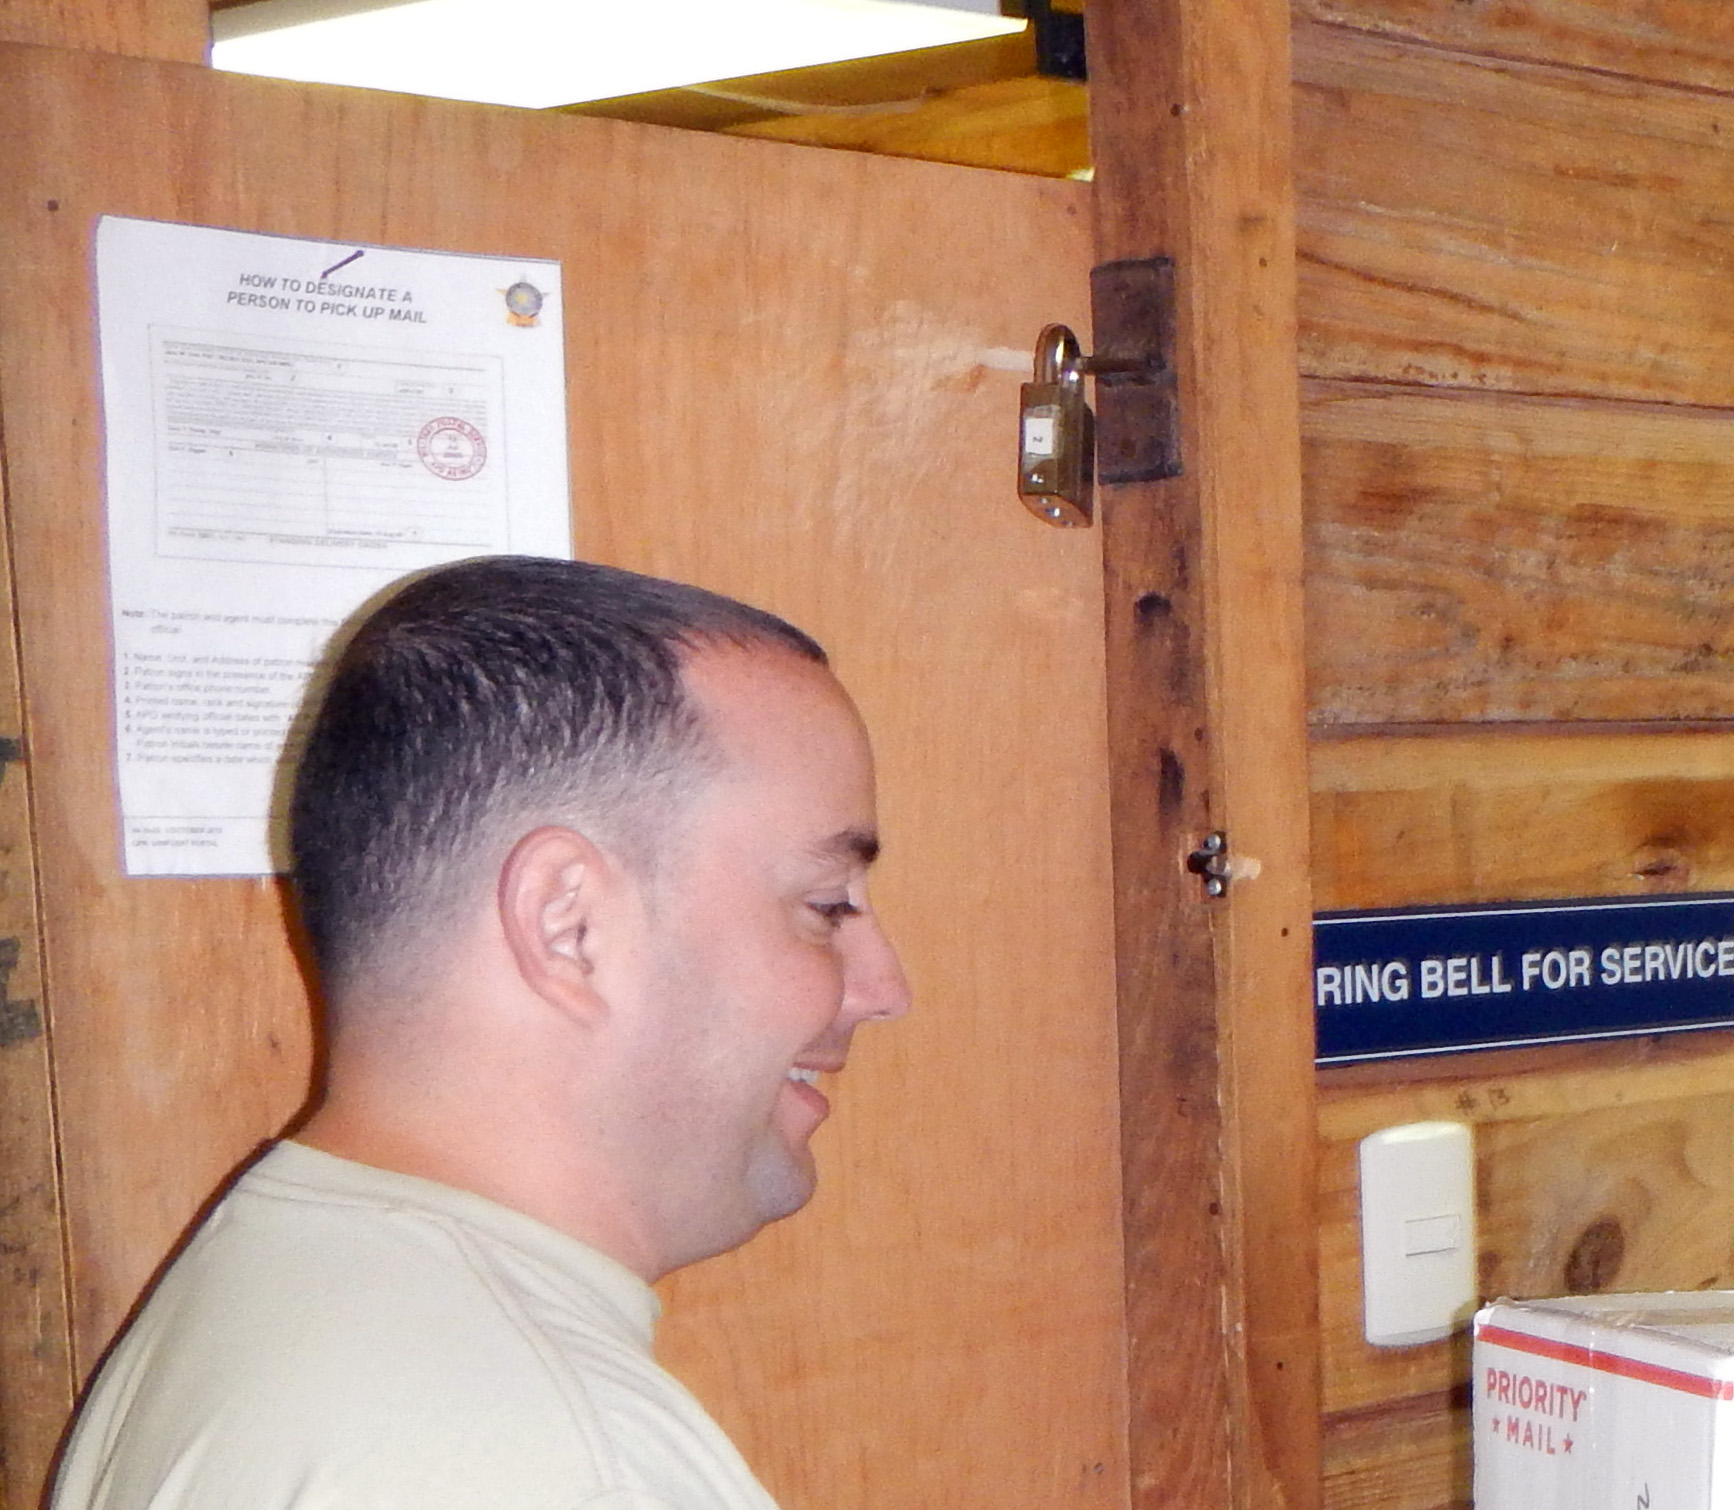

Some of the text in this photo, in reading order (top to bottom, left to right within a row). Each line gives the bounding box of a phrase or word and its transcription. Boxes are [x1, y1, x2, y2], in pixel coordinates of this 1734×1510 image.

[226, 290, 428, 324] PERSON TO PICK UP MAIL
[239, 273, 413, 303] HOW TO DESIGNATE A
[1315, 961, 1409, 1007] RING
[1420, 954, 1511, 999] BELL
[1521, 950, 1593, 991] FOR
[1486, 1367, 1587, 1423] PRIORITY
[1506, 1415, 1556, 1456] MAIL
